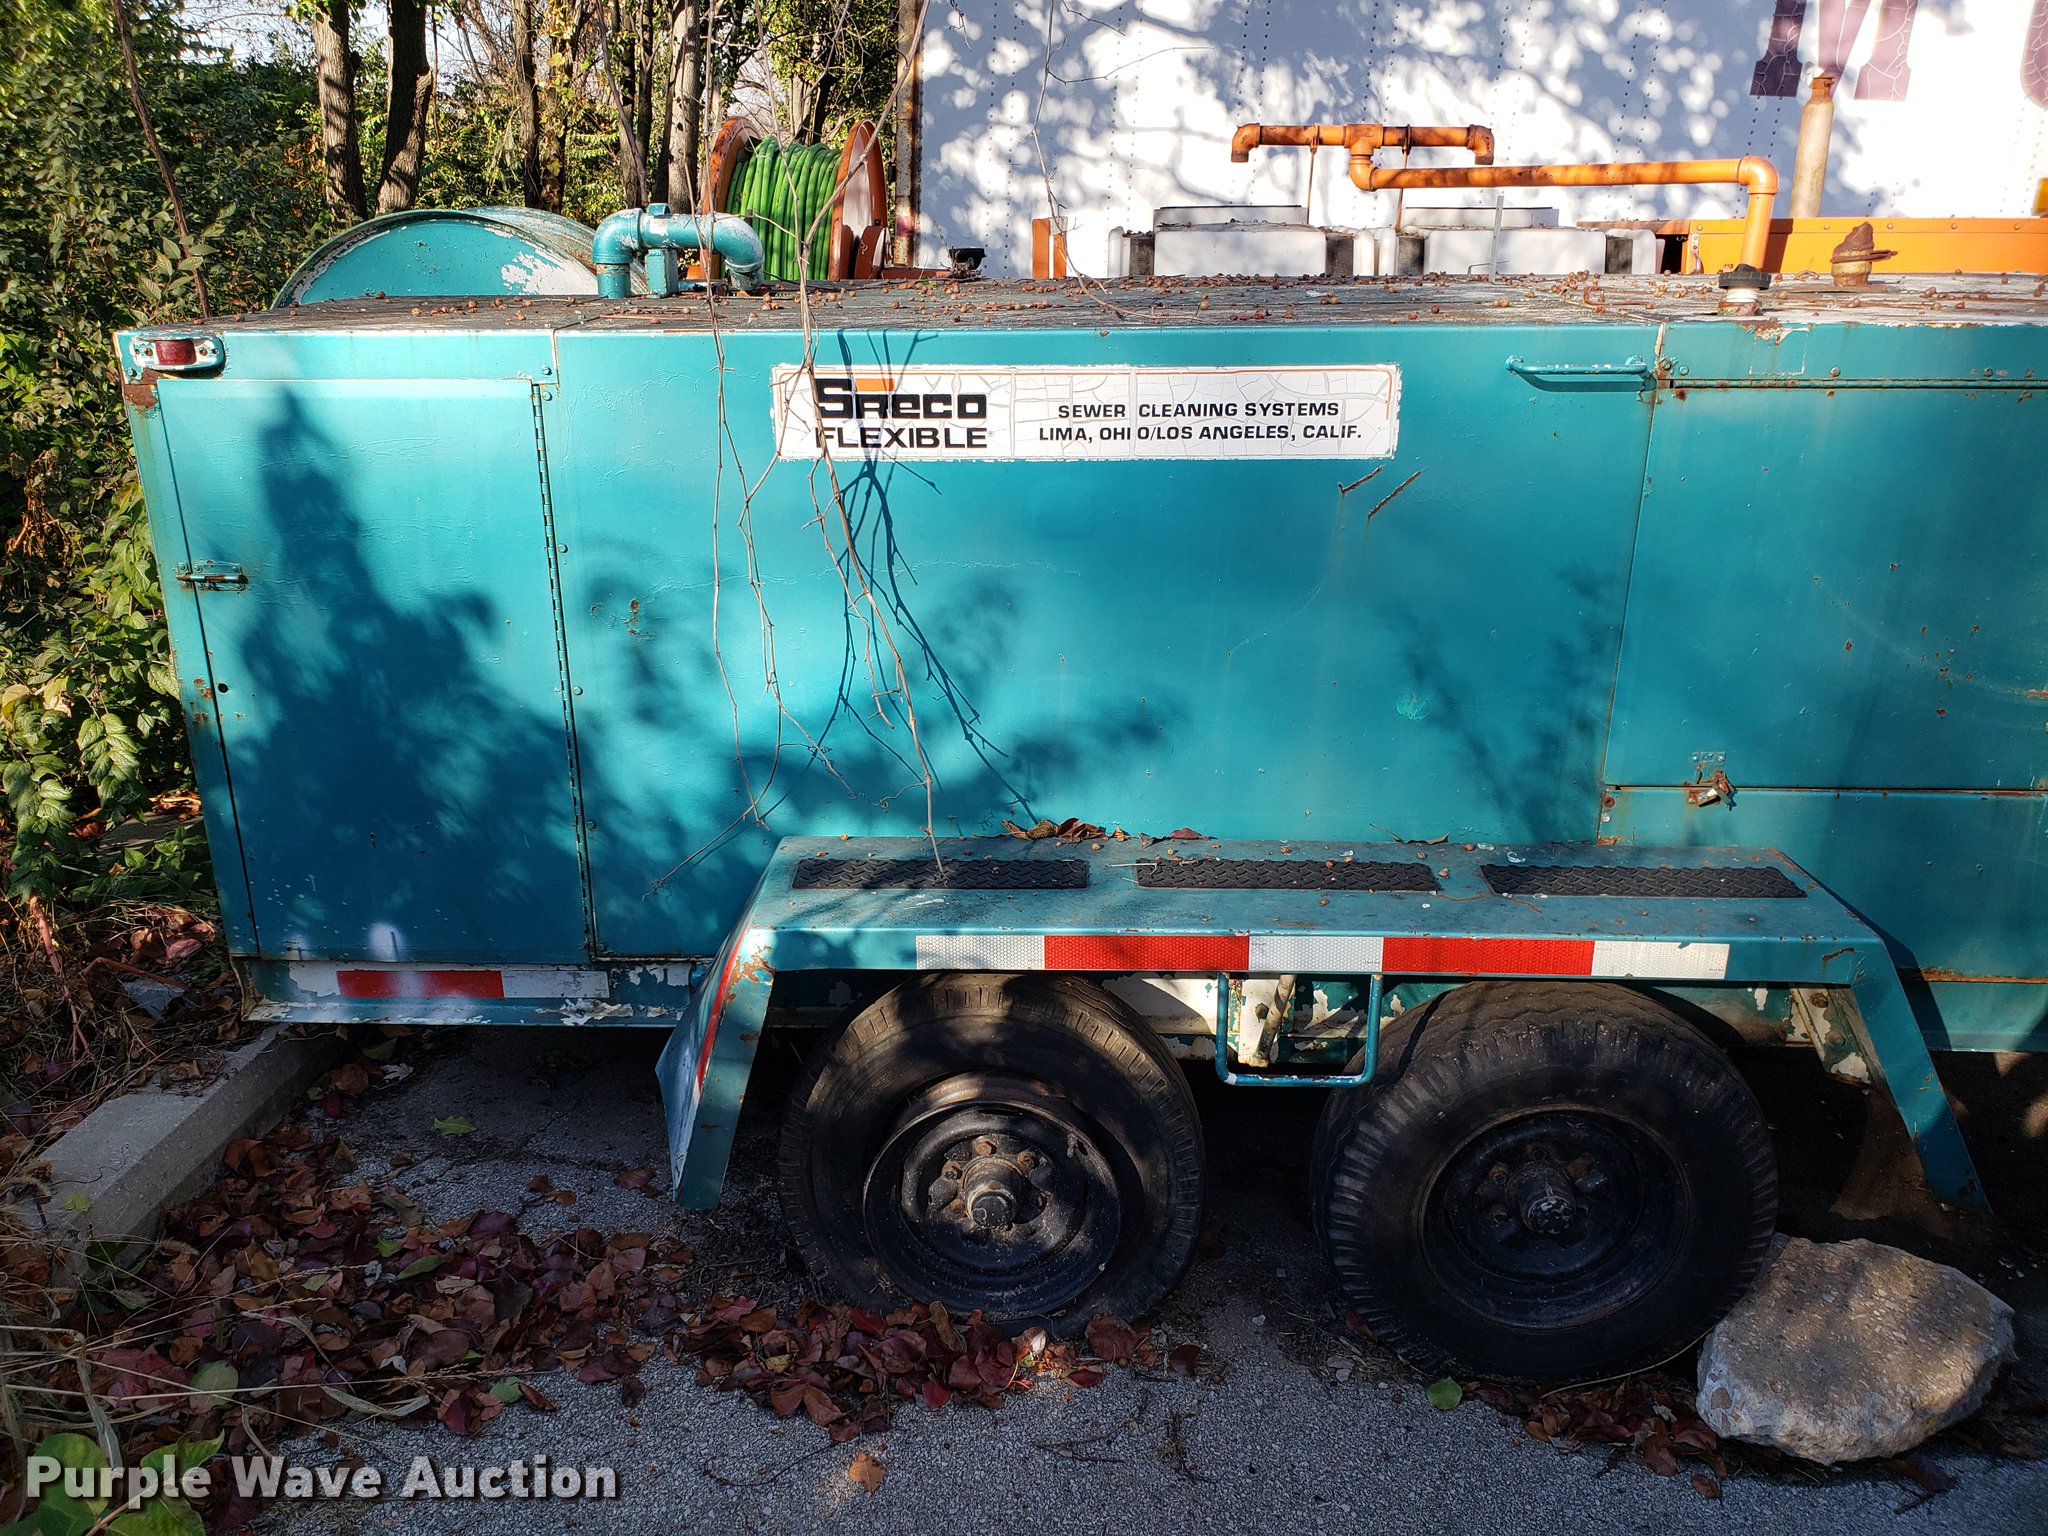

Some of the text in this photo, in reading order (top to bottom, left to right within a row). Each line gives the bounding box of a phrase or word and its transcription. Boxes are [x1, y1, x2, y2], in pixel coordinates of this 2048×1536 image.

[1058, 402, 1339, 418] SEWER CLEANING SYSTEMS
[1039, 427, 1093, 444] LIMA,
[1199, 425, 1296, 442] ANGELES,
[1302, 424, 1362, 440] CALIF.
